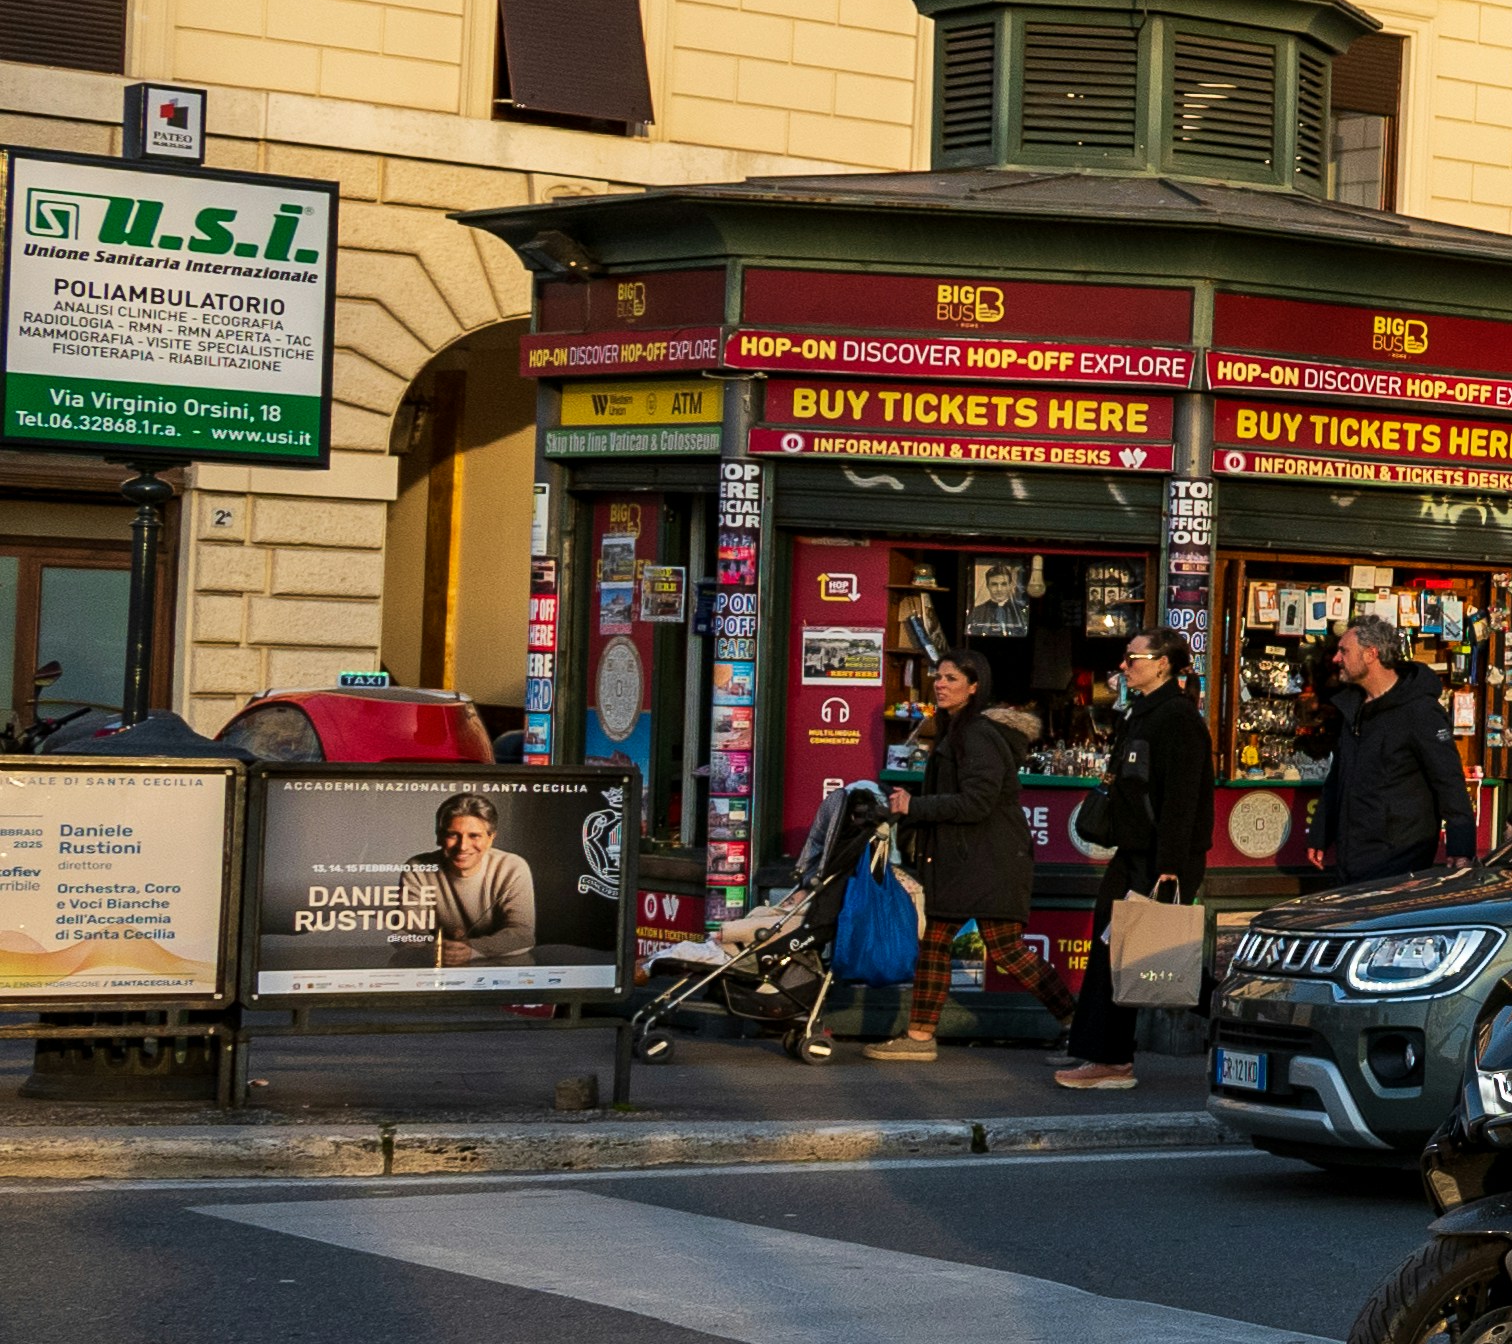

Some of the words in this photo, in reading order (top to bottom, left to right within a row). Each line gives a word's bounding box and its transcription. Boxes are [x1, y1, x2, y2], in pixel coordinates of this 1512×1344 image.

[152, 131, 193, 144] PATEO
[24, 243, 90, 261] Unione
[96, 250, 180, 271] Sanitaria
[186, 260, 319, 284] Internazionale
[54, 278, 286, 316] POLIAMBULATORIO
[618, 283, 634, 300] BIG
[937, 284, 974, 304] BIG
[54, 301, 113, 316] ANALISI
[118, 306, 188, 322] CLINICHE
[202, 313, 284, 331] ECOGRAFIA
[937, 303, 974, 321] BUS
[24, 312, 114, 329] RADIOLOGIA
[129, 321, 163, 334] RMN
[178, 326, 211, 339] RMN
[215, 329, 271, 343] APERTA
[286, 334, 312, 347] TAC
[1374, 316, 1404, 335] BIG
[19, 326, 133, 346] MAMMOGRAFIA
[147, 337, 191, 351] VISITE
[198, 341, 315, 361] SPECIALISTICHE
[1373, 334, 1403, 352] BUS
[53, 343, 154, 362] FISIOTERAPIA
[169, 352, 281, 372] RIABILITAZIONE
[529, 348, 567, 368] HOP-ON
[569, 344, 619, 366] DISCOVER
[621, 342, 667, 364] HOP-OFF
[669, 339, 718, 360] EXPLORE
[740, 336, 836, 360] HOP-ON
[843, 341, 960, 367] DISCOVER
[967, 347, 1075, 372] HOP-OFF
[1080, 353, 1186, 378] EXPLORE
[1217, 361, 1301, 387] HOP-ON
[1304, 369, 1402, 395] DISCOVER
[1406, 379, 1492, 404] HOP-OFF
[50, 389, 84, 408] Via
[91, 392, 177, 416] Virginio
[184, 399, 255, 423] Orsini,
[260, 405, 281, 422] 18
[671, 392, 702, 415] ATM
[793, 388, 870, 421] BUY
[878, 391, 1038, 428] TICKETS
[1048, 399, 1149, 434] HERE
[212, 427, 312, 446] www.usi.it
[1236, 409, 1303, 443] BUY
[1309, 414, 1442, 453] TICKETS
[546, 432, 566, 453] Skip
[569, 432, 586, 452] the
[587, 431, 608, 452] line
[610, 431, 648, 452] Vatican
[661, 430, 720, 452] Colosseum
[813, 437, 943, 458] INFORMATION
[950, 443, 964, 458] &
[968, 444, 1045, 462] TICKETS
[1050, 447, 1111, 466] DESKS
[1254, 456, 1375, 481] INFORMATION
[1380, 465, 1391, 481] &
[1396, 467, 1464, 487] TICKETS
[611, 504, 626, 523] BIG
[345, 676, 381, 685] TAXI
[64, 778, 79, 786] DI
[86, 778, 136, 787] SANTA
[143, 778, 204, 787] CECILIA
[283, 782, 370, 791] ACCADEMIA
[375, 783, 457, 792] NAZIONALE
[463, 784, 477, 792] DI
[482, 783, 528, 793] SANTA
[533, 784, 589, 793] CECILIA
[60, 824, 133, 837] Daniele
[13, 841, 43, 849] 2025
[59, 841, 141, 854] Rustioni
[58, 861, 112, 870] direttore
[346, 864, 358, 873] 15
[359, 864, 411, 873] FEBBRAIO
[412, 863, 439, 873] 2025
[57, 883, 140, 894] Orchestra,
[144, 883, 181, 893] Coro
[308, 885, 437, 907] DANIELE
[69, 898, 103, 909] Voci
[107, 898, 170, 909] Bianche
[56, 914, 171, 925] dell'Accademia
[294, 909, 436, 932] RUSTIONI
[55, 929, 69, 940] di
[73, 929, 119, 940] Santa
[124, 929, 175, 940] Cecilia
[387, 933, 434, 943] direttore
